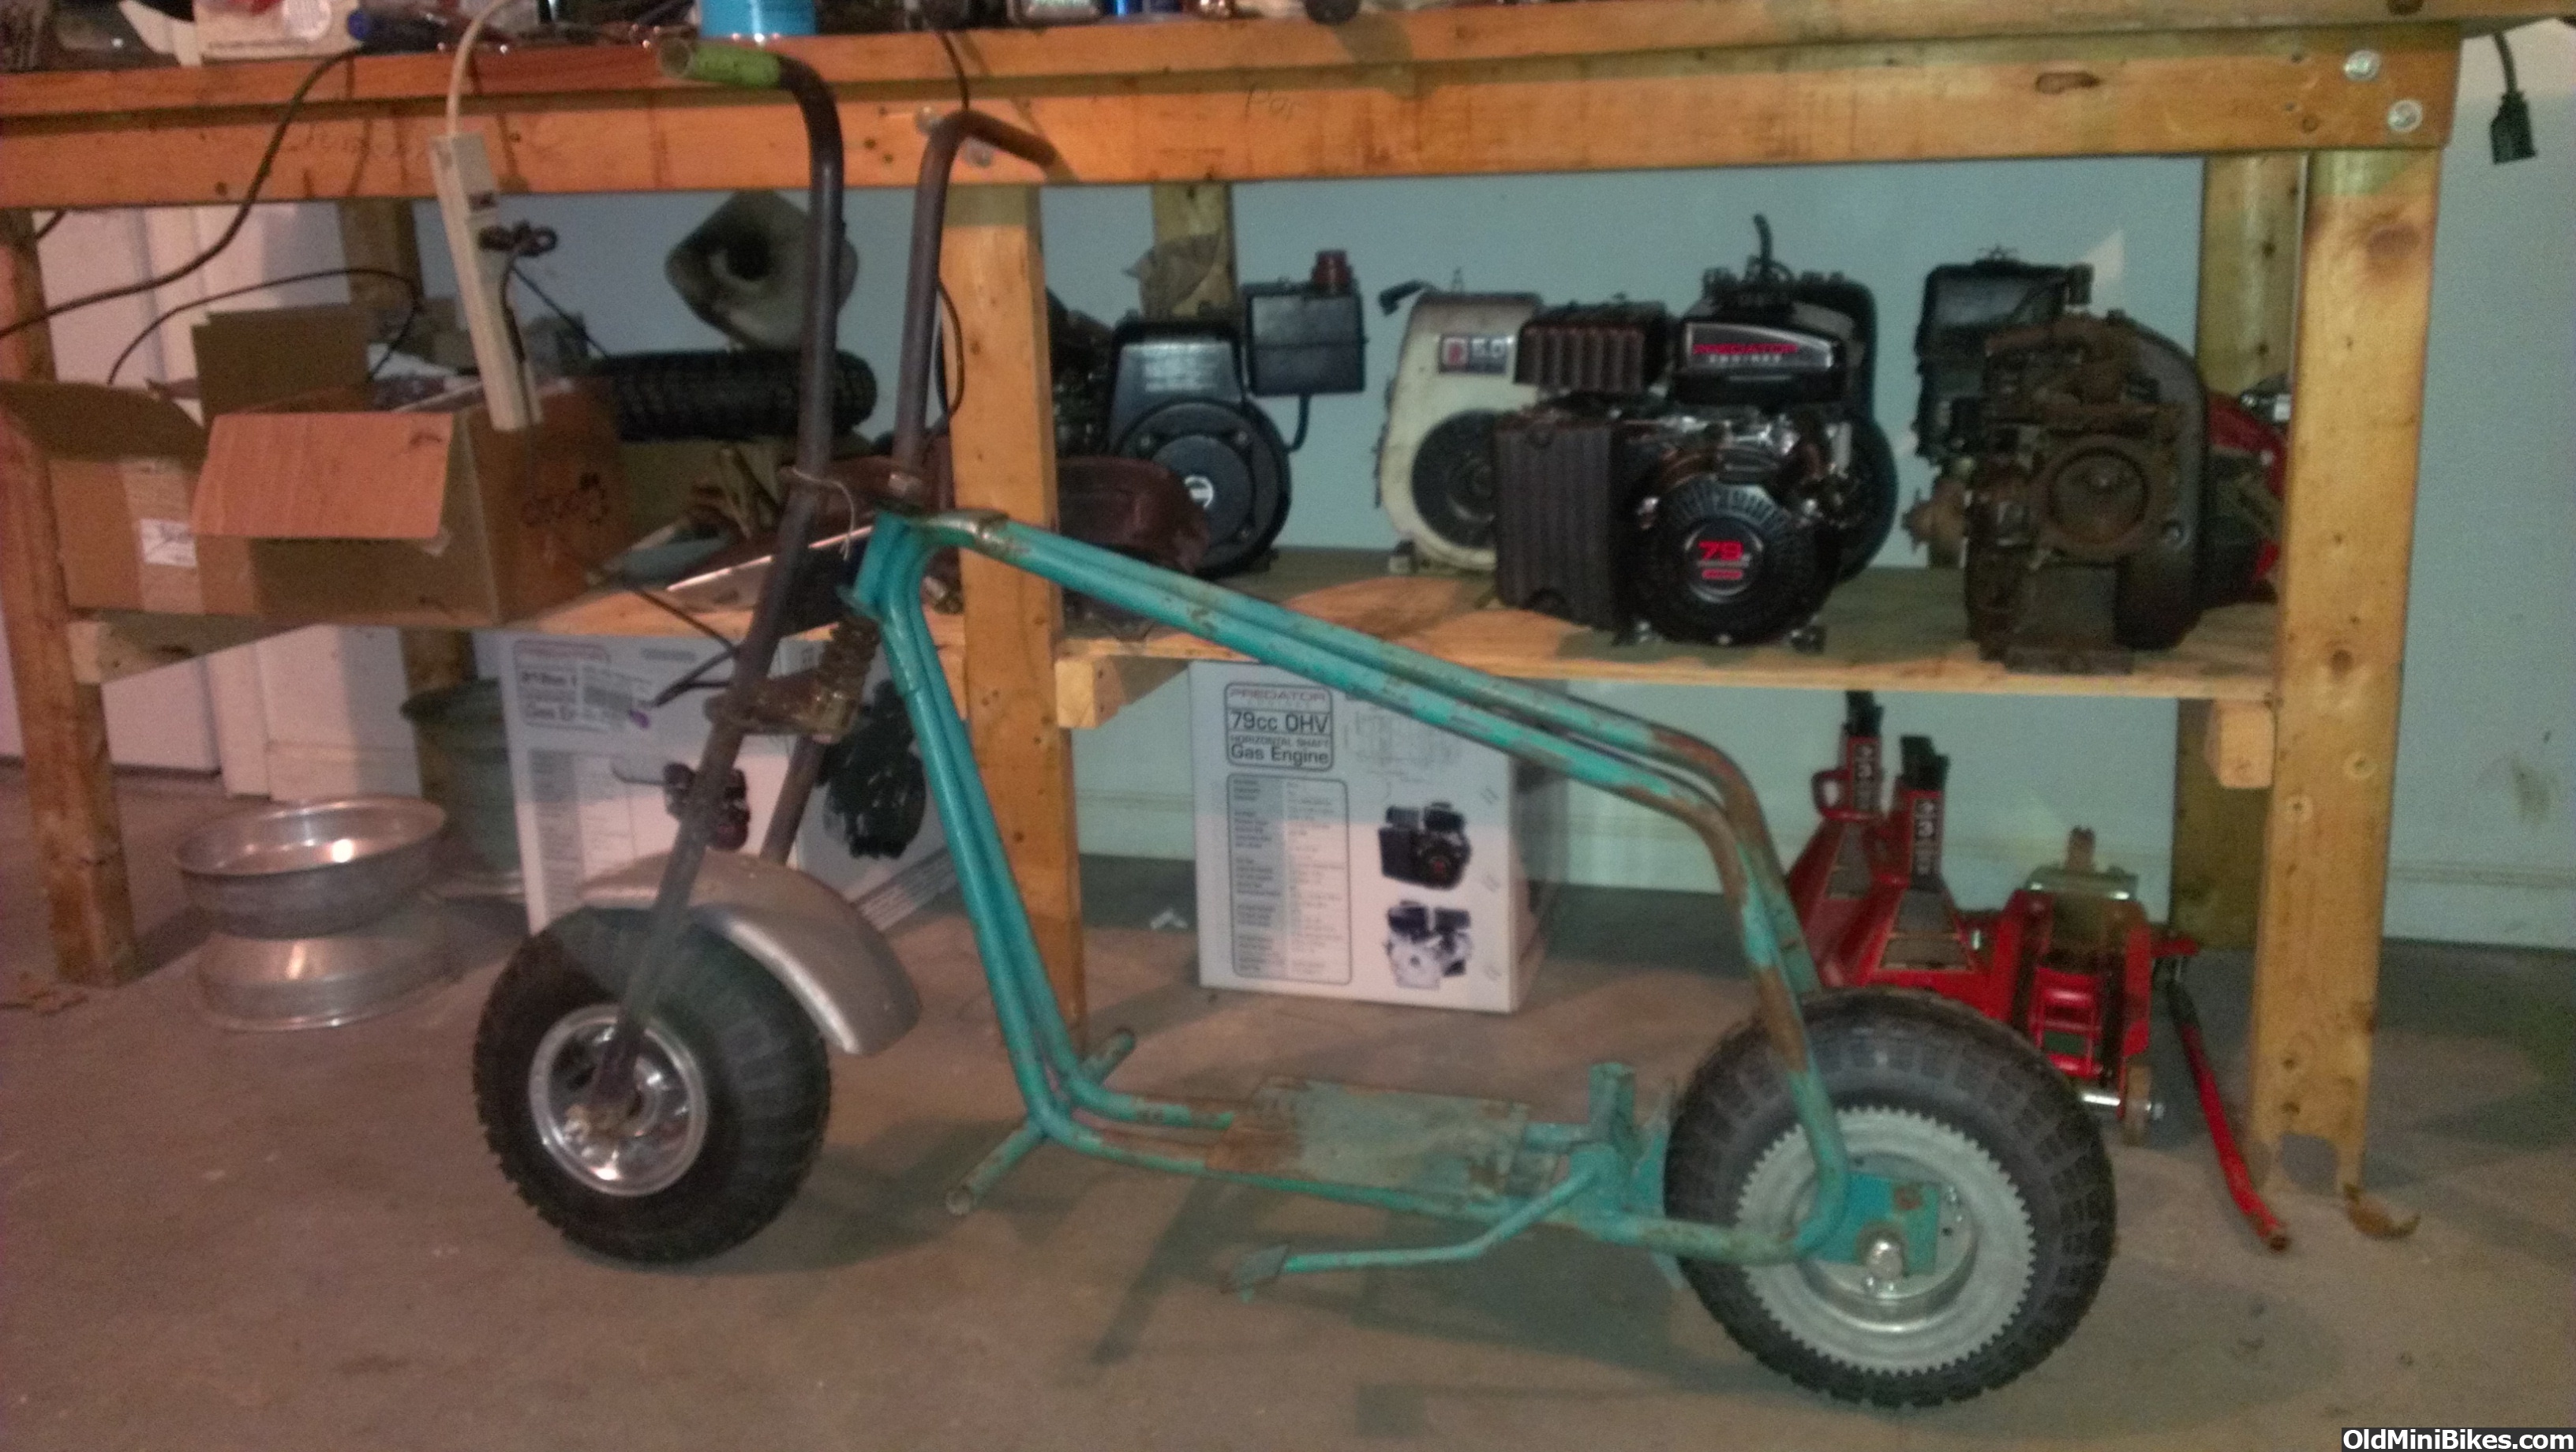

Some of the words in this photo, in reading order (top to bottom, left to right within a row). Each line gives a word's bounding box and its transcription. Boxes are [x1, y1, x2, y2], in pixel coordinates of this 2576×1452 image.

[1230, 711, 1279, 731] 79cc
[1286, 713, 1329, 733] OHV
[1231, 743, 1264, 759] Gas
[1271, 747, 1329, 768] Engine
